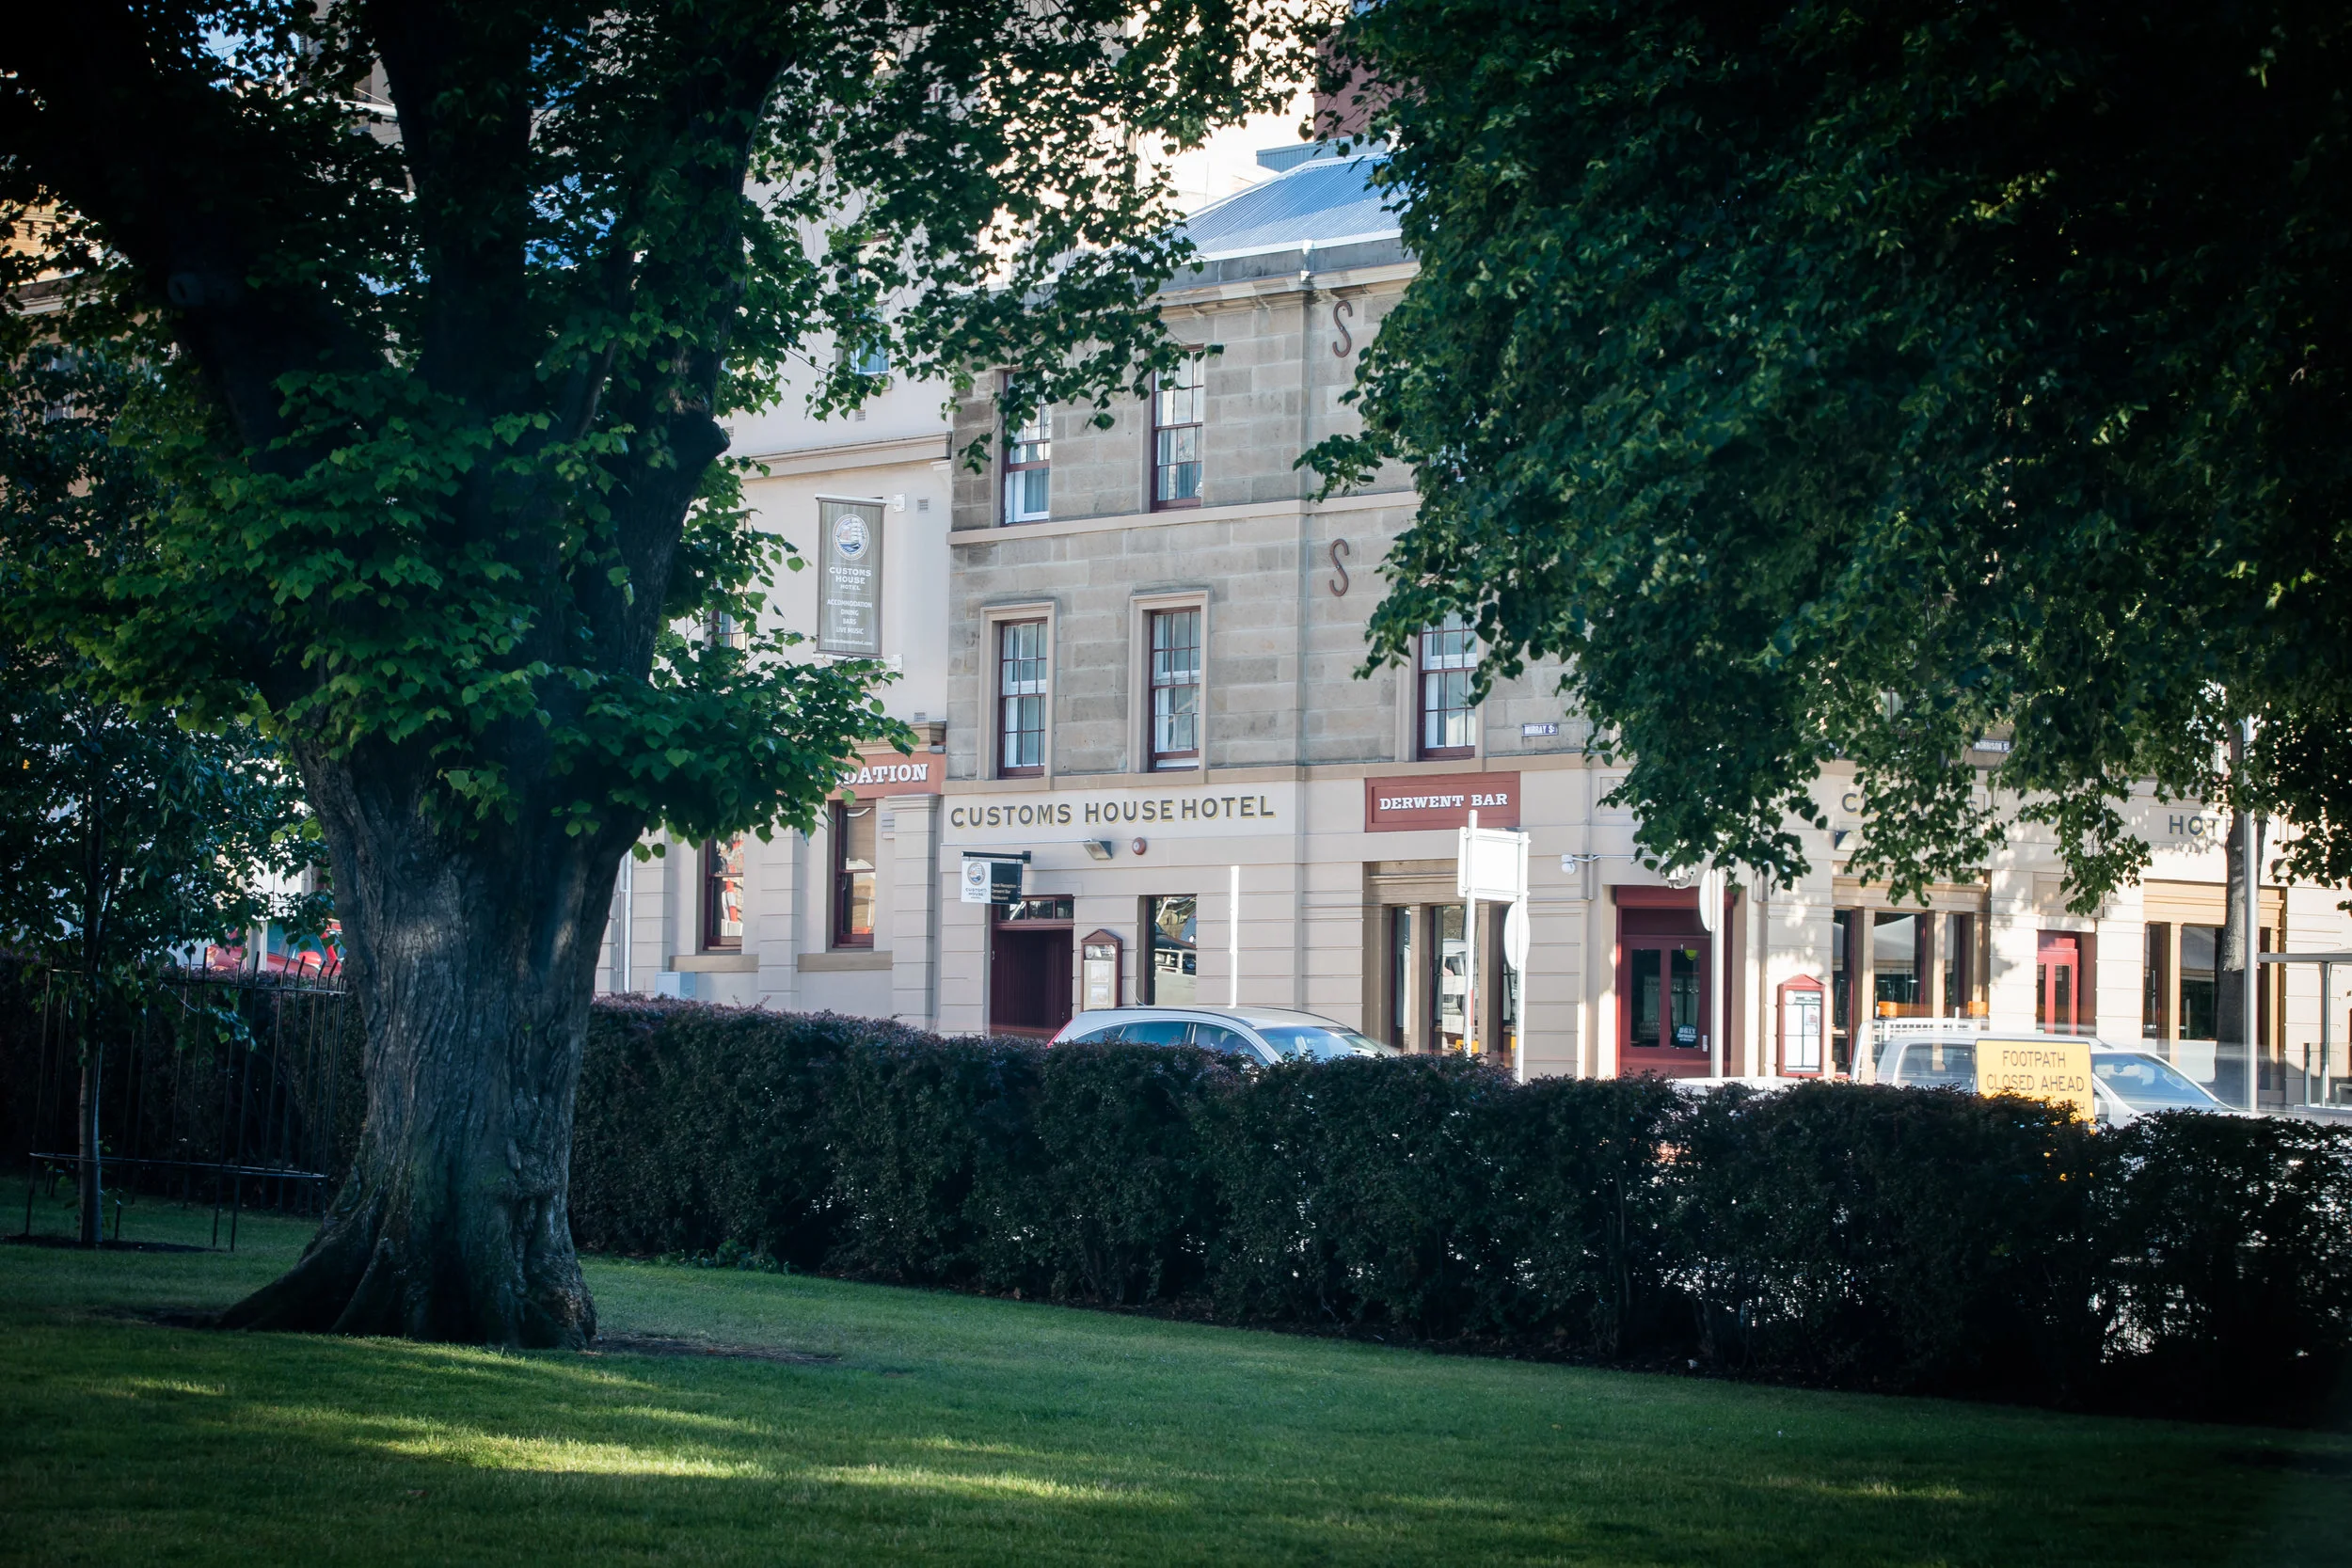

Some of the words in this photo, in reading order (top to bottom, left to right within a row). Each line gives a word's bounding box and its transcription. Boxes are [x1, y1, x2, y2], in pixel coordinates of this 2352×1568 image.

[829, 566, 872, 577] CUSTOMS
[835, 576, 866, 584] HOUSE
[835, 763, 929, 784] DATION
[1379, 795, 1465, 810] DERWENT
[1470, 793, 1508, 807] BAR
[950, 803, 1072, 829] CUSTOMS
[1085, 799, 1174, 824] HOUSE
[1181, 795, 1277, 819] HOTEL
[2002, 1050, 2066, 1069] FOOTPATH
[1986, 1073, 2035, 1091] CLOSED
[2040, 1075, 2085, 1092] AHEAD
